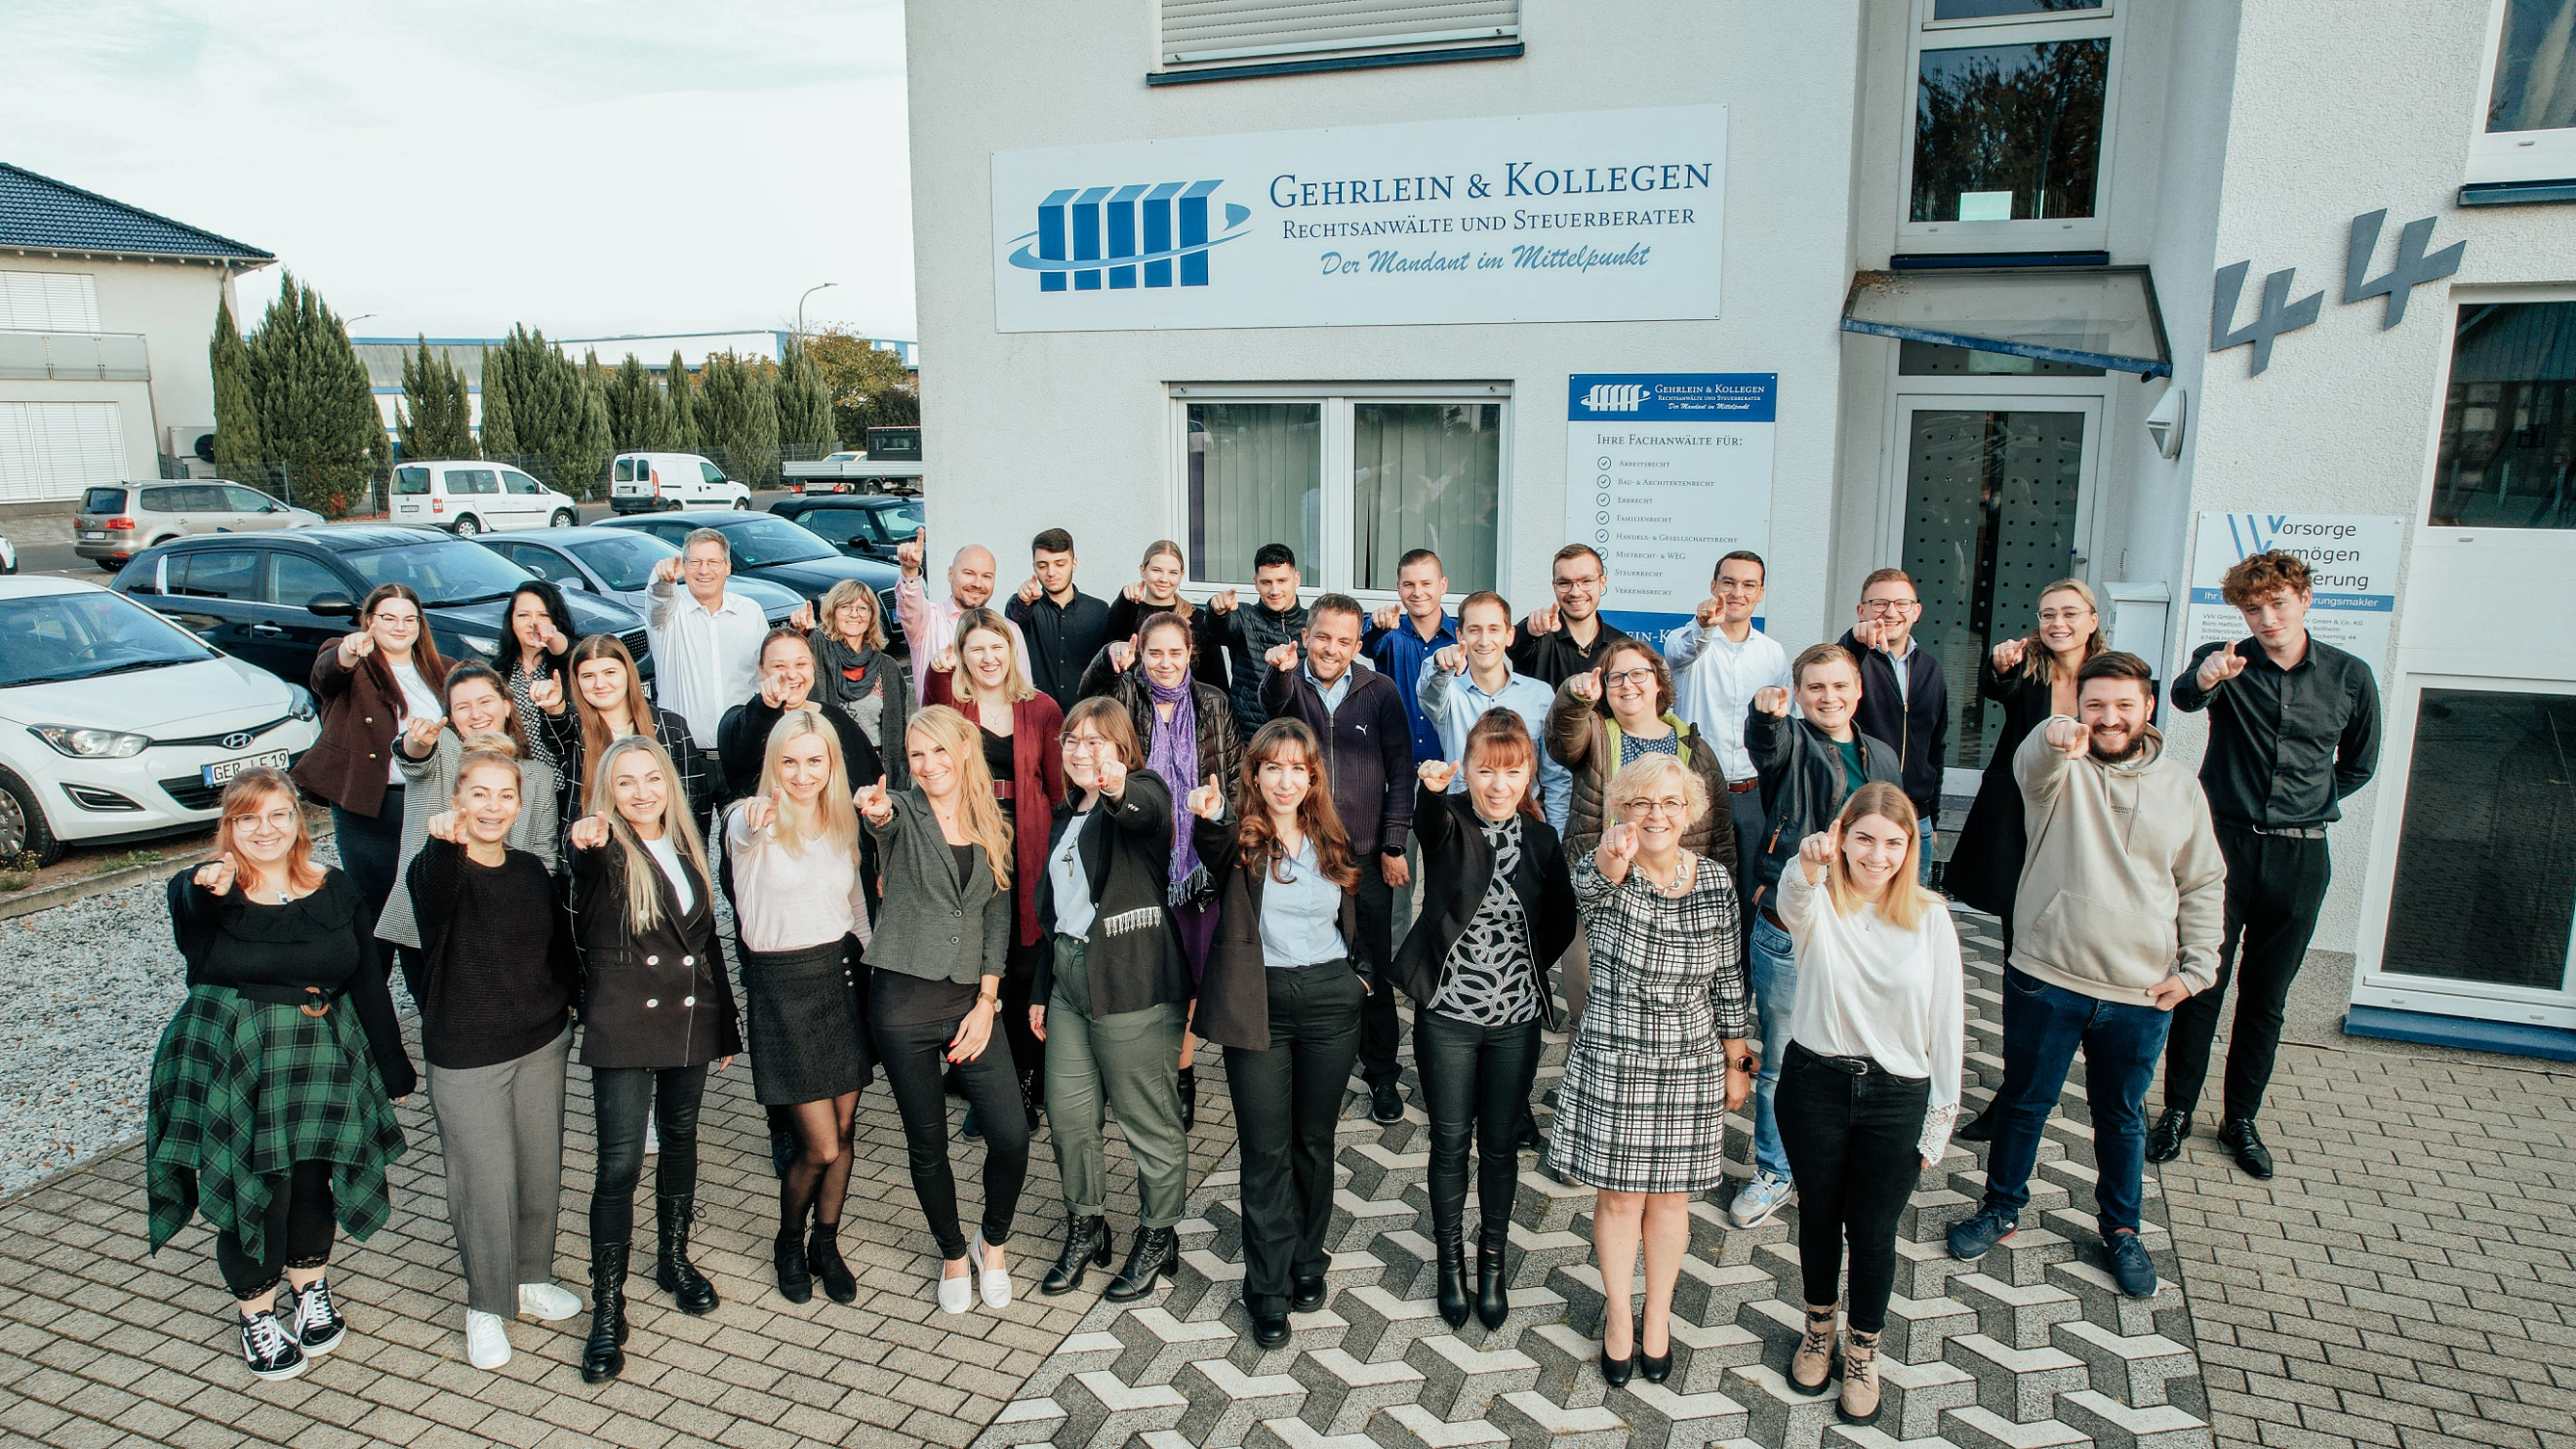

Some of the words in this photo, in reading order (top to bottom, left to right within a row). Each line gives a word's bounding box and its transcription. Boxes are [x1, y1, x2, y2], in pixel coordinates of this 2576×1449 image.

[1269, 173, 1454, 209] GEHRLEIN
[1468, 173, 1492, 199] &
[1504, 161, 1713, 198] KOLLEGEN
[1283, 215, 1454, 239] RECHTSANWÄLTE
[1462, 216, 1507, 232] UND
[1512, 208, 1696, 230] STEUERBERATER
[1320, 251, 1361, 275] Der
[1367, 247, 1470, 274] Mandant
[1477, 251, 1505, 268] im
[1511, 242, 1651, 274] Mittelpunkt
[1654, 383, 1704, 393] GEHRLEIN
[1714, 383, 1765, 393] KOLLEGEN
[1596, 433, 1626, 445] IHRE
[1629, 433, 1711, 446] FACHANWÄLTE
[1716, 435, 1743, 446] FÜR:
[1616, 514, 1672, 523] FAMILIENRECHT
[2267, 514, 2357, 540] Vorsorge
[1659, 534, 1738, 543] GESELLSCHAFTSRECHT
[1615, 569, 1663, 578] STEUERRECHT
[2312, 574, 2369, 590] erung
[2204, 591, 2218, 600] Ihr
[1625, 628, 1671, 643] EIN-K
[214, 763, 240, 781] GER
[271, 752, 287, 768] 19
